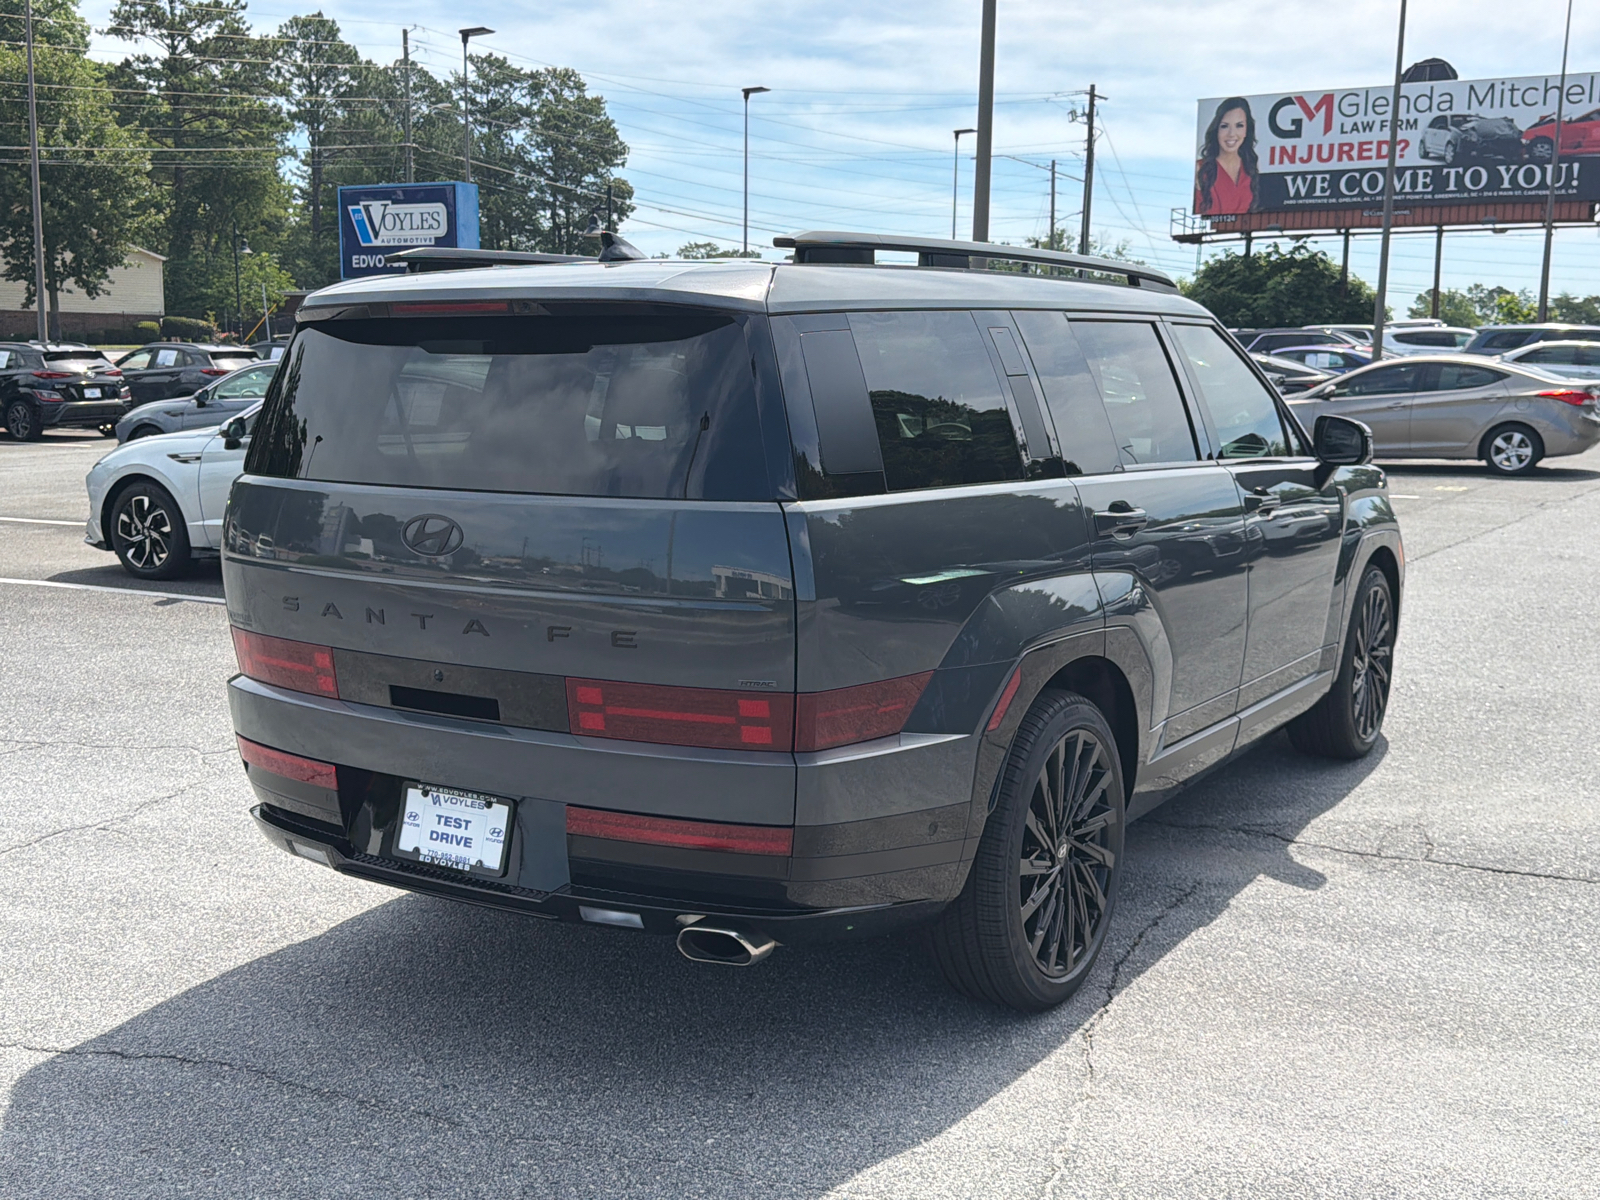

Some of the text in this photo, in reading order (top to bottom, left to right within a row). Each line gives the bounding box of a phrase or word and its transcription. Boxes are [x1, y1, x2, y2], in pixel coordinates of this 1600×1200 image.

[1337, 86, 1454, 118] Glenda
[1268, 93, 1334, 139] GM
[1340, 120, 1375, 134] LAW
[1269, 139, 1410, 165] INJURED?
[1284, 162, 1580, 198] WE COME TO YOU!
[362, 203, 441, 240] VOYLES
[282, 595, 490, 637] SANTA
[546, 625, 638, 649] FE
[443, 795, 485, 810] VOYLES
[435, 814, 472, 831] TEST
[429, 830, 473, 848] DRIVE
[418, 854, 432, 863] ED
[434, 857, 471, 871] VOYLES
